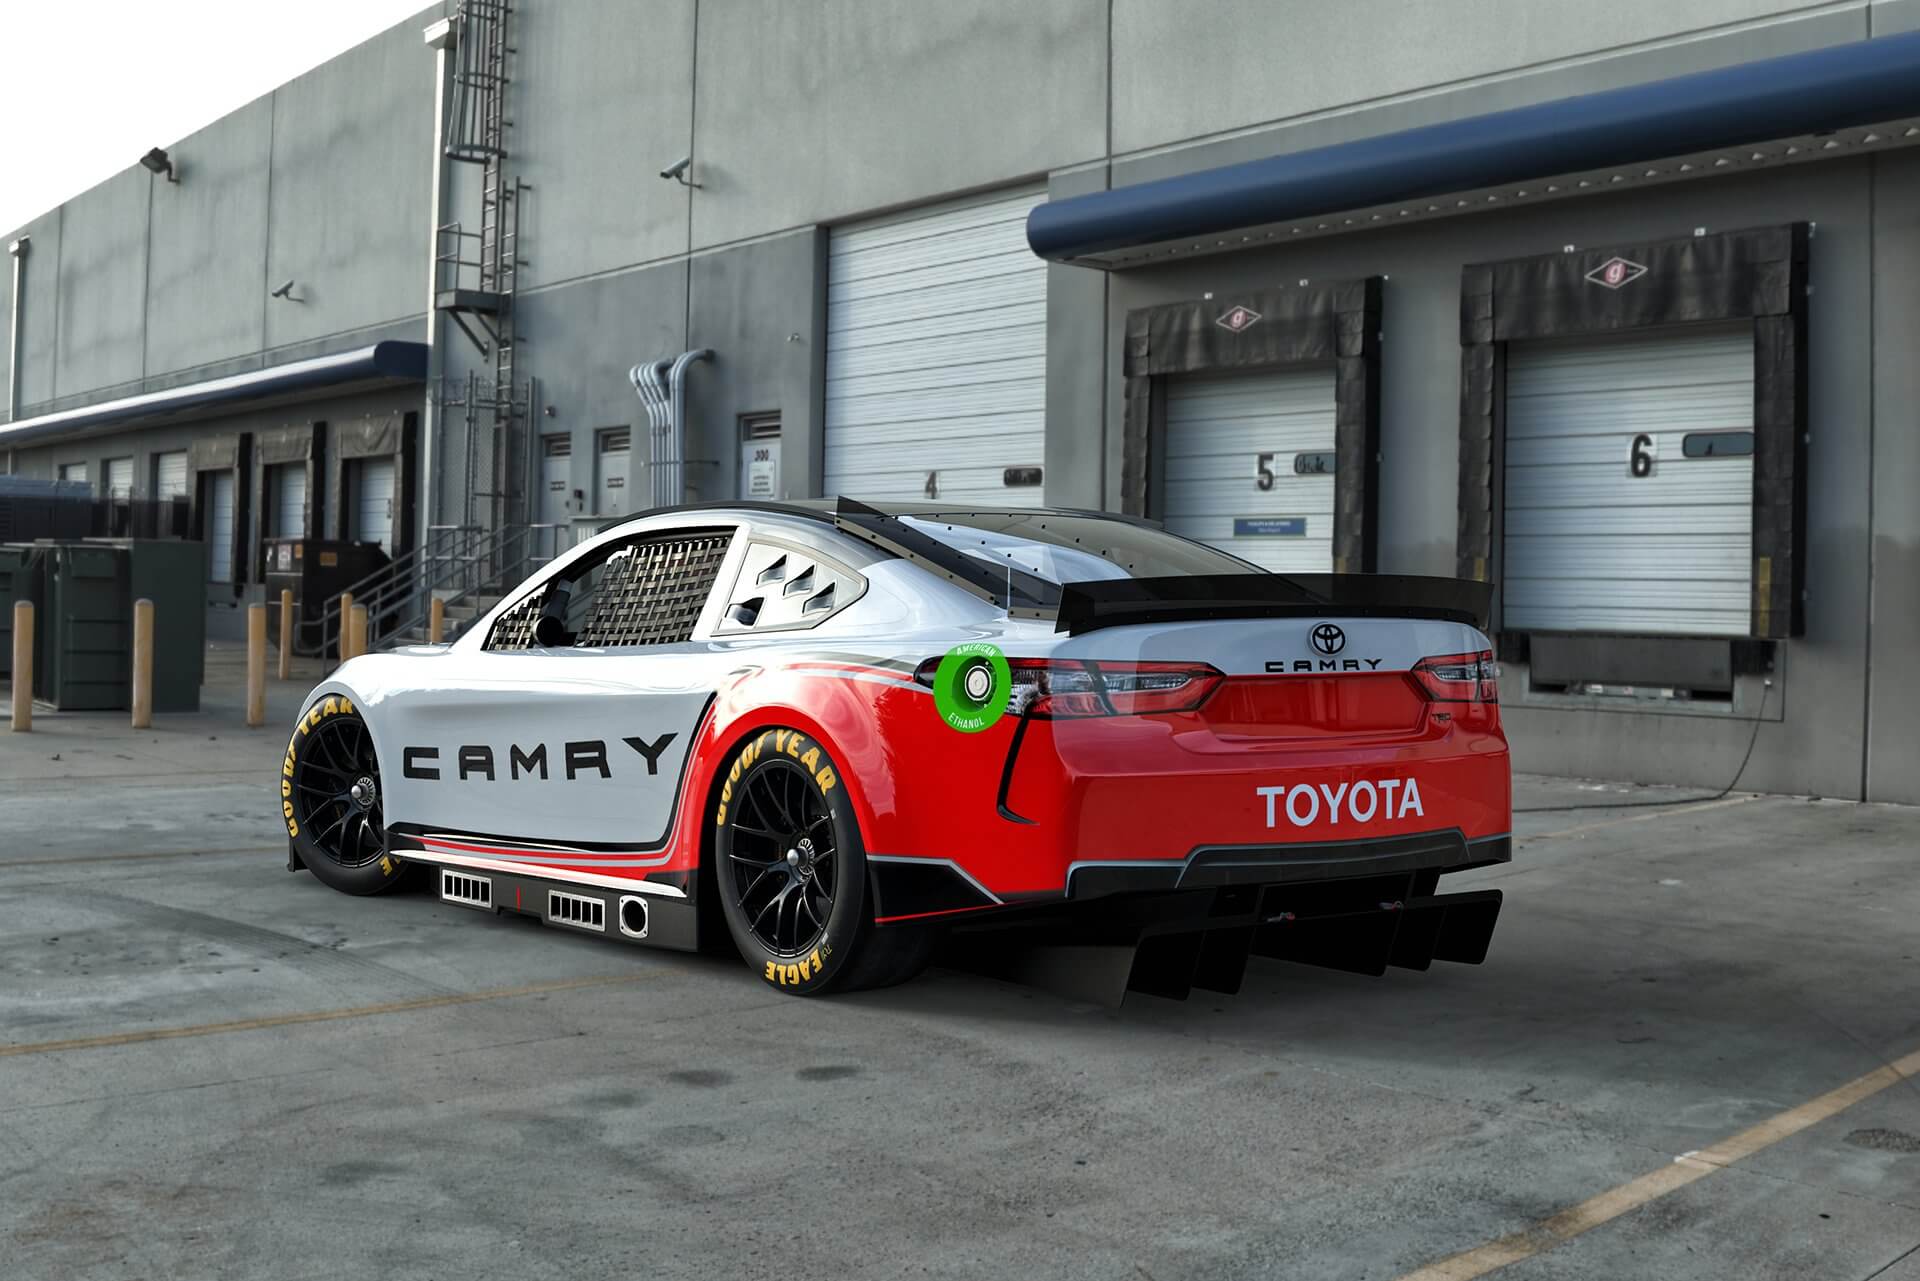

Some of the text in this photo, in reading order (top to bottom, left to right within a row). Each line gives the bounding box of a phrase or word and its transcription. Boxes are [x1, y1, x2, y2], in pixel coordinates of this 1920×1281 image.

[1257, 454, 1274, 491] 5
[1630, 434, 1653, 478] 6
[925, 471, 938, 499] 4
[956, 643, 997, 657] AMERICAN
[1265, 658, 1383, 673] CAMRY
[948, 712, 985, 729] ETHANOL
[403, 732, 679, 781] CAMRY
[1256, 777, 1425, 828] TOYOTA
[765, 947, 824, 985] EAGLE
